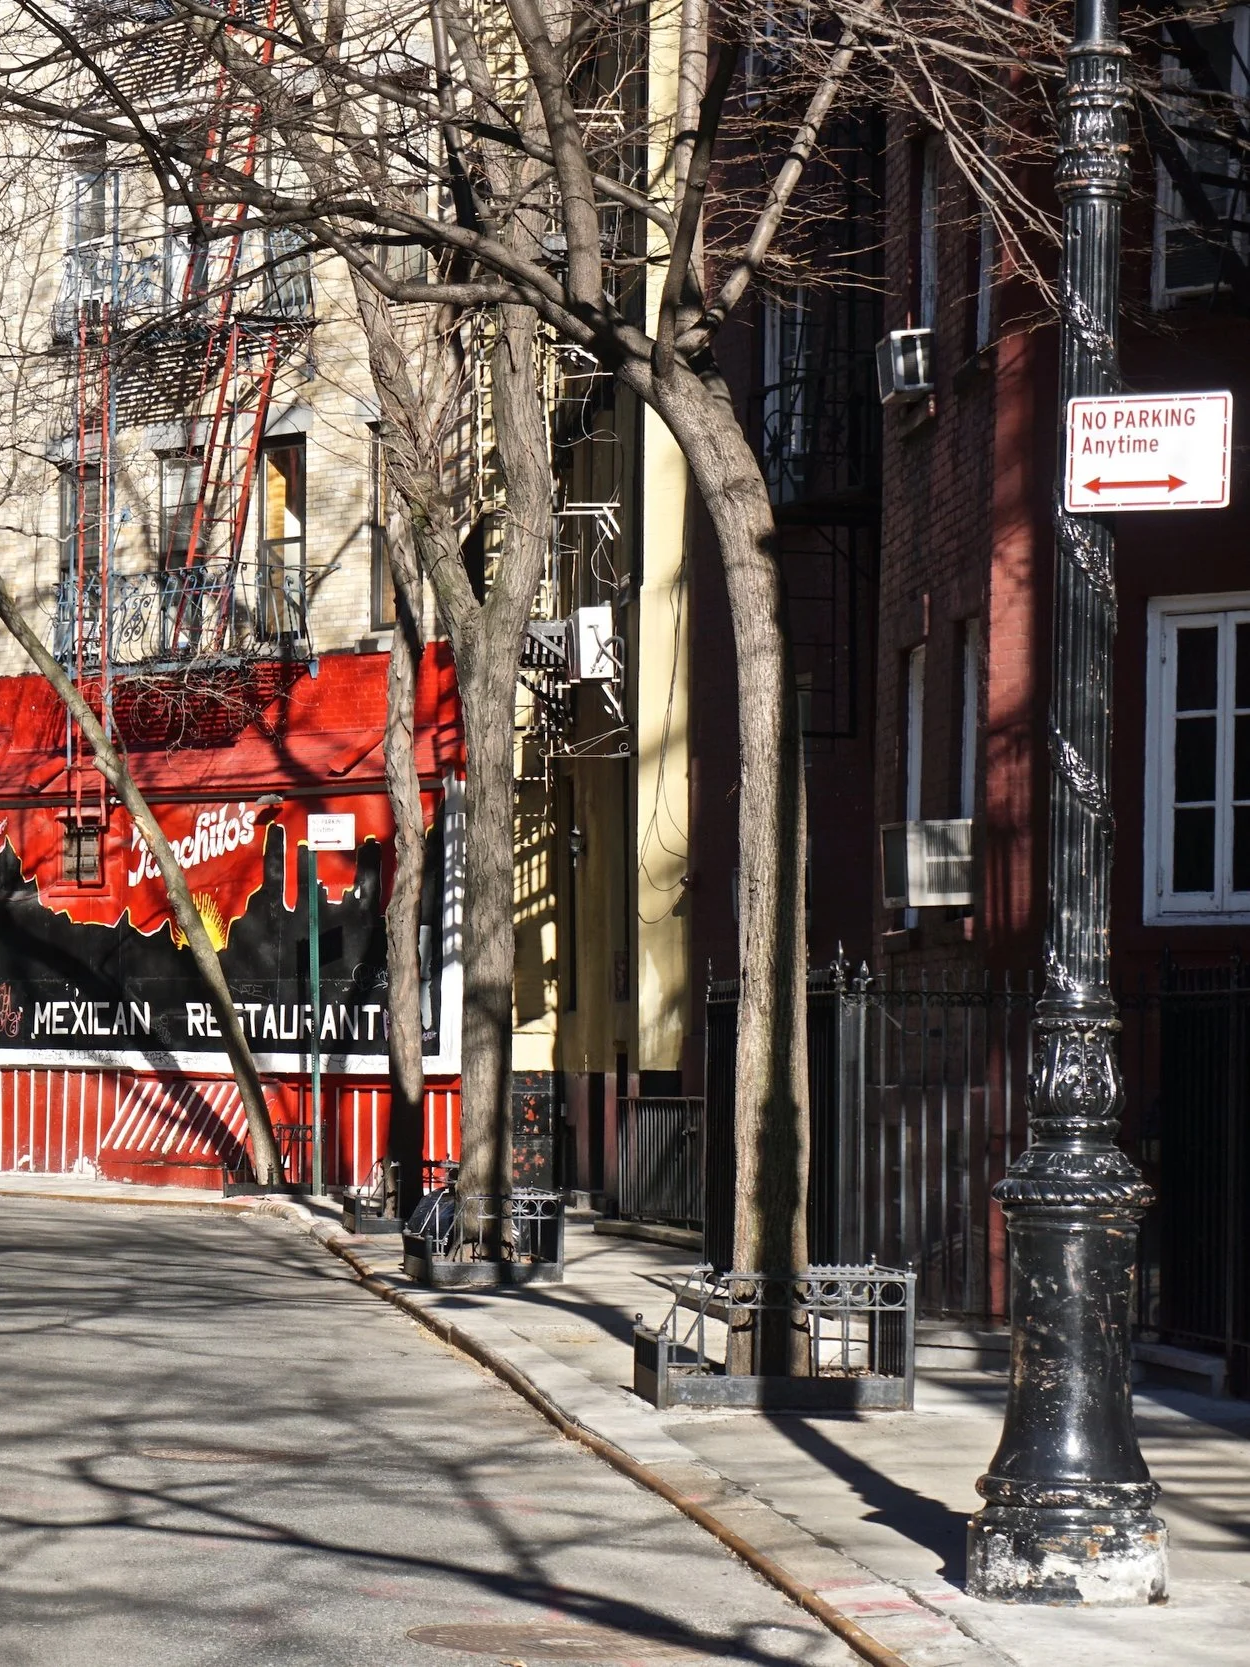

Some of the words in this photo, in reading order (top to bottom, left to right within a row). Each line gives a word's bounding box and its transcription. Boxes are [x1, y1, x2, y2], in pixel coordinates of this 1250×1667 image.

[1082, 411, 1107, 430] NO
[1113, 407, 1197, 429] PARKING
[1082, 435, 1159, 459] Anytime
[33, 1001, 151, 1035] MEXICAN
